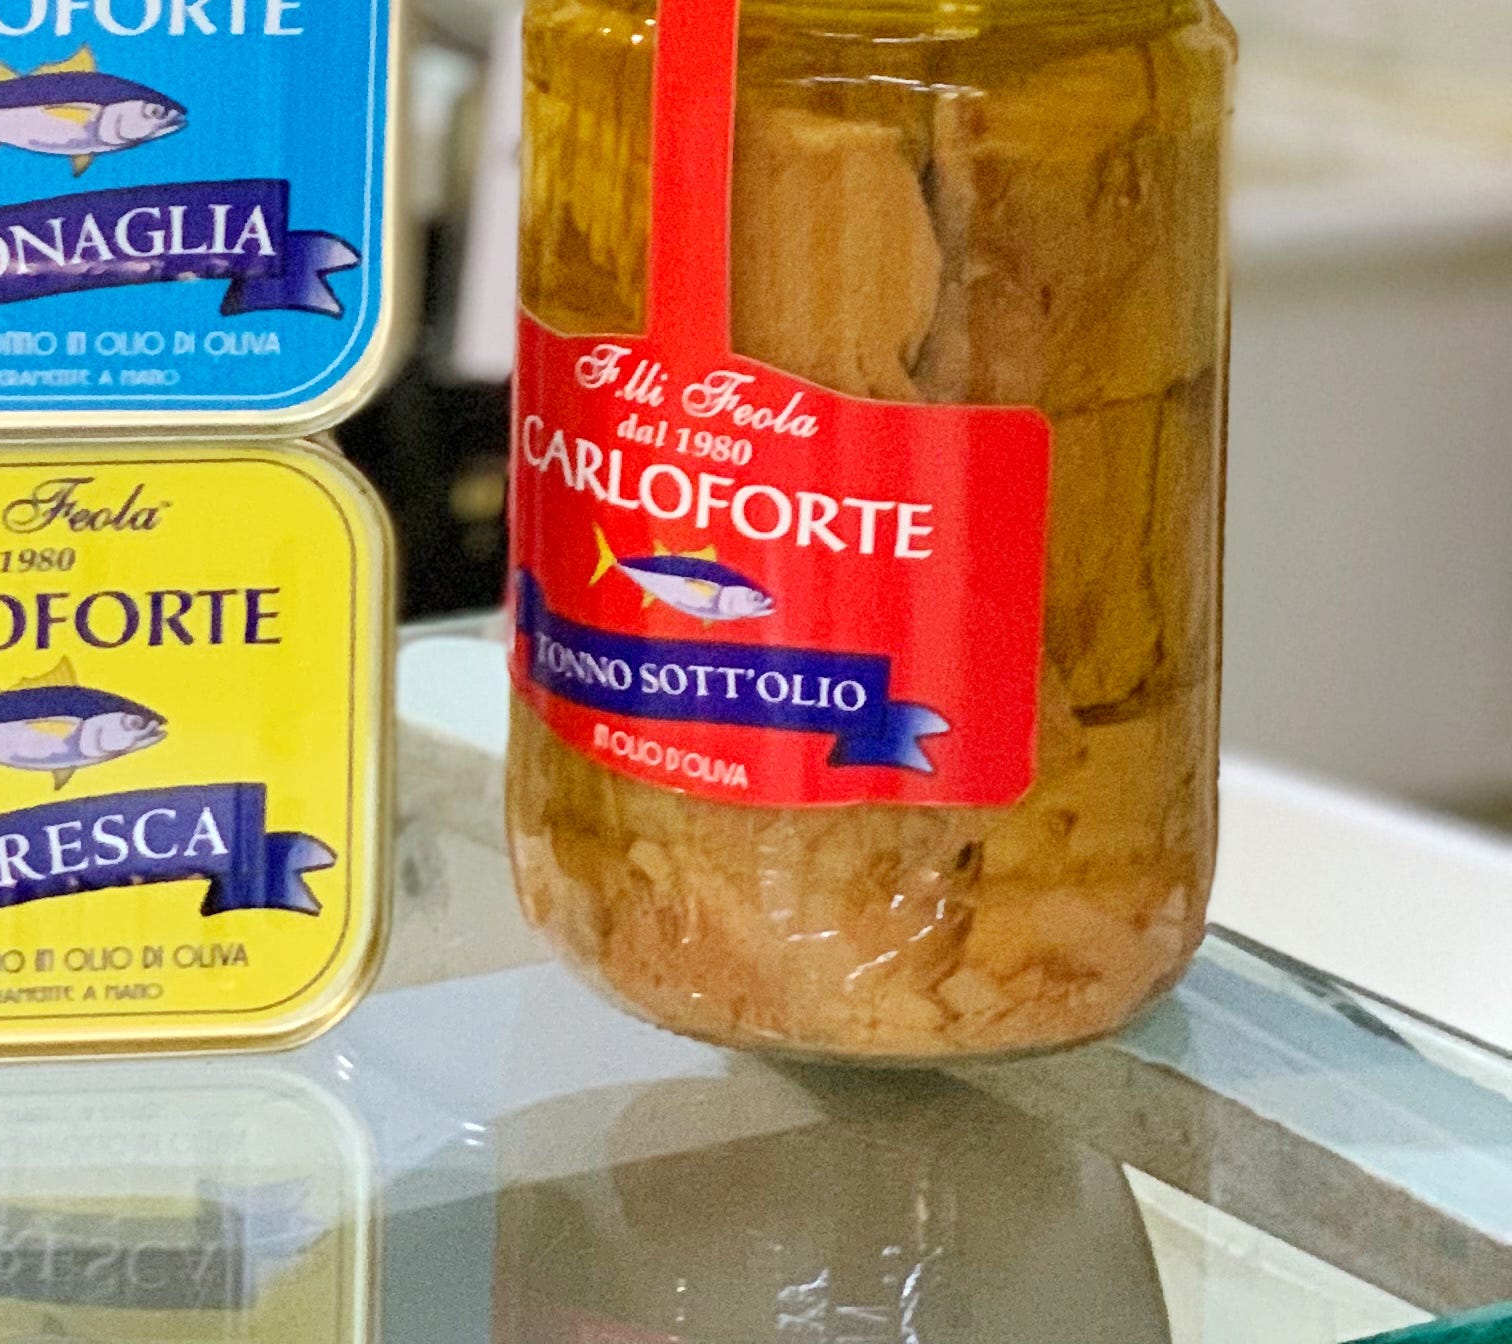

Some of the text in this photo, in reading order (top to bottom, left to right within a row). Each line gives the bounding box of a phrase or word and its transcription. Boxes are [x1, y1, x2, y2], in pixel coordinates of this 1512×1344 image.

[94, 330, 165, 356] OLIO
[173, 330, 195, 355] DI
[204, 330, 281, 356] OLIVA
[98, 370, 113, 386] A
[682, 369, 820, 438] Feola
[617, 413, 753, 467] dal 1980
[1, 476, 159, 535] Feola
[521, 414, 935, 560] CARLOFORTE
[535, 632, 868, 712] TONNO SOTT'OLIO
[610, 730, 663, 766] OLIO
[666, 746, 748, 790] D'OLIVA
[64, 946, 133, 972] OLIO
[142, 945, 165, 969] DI
[173, 943, 250, 969] OLIVA
[83, 985, 97, 1002] A
